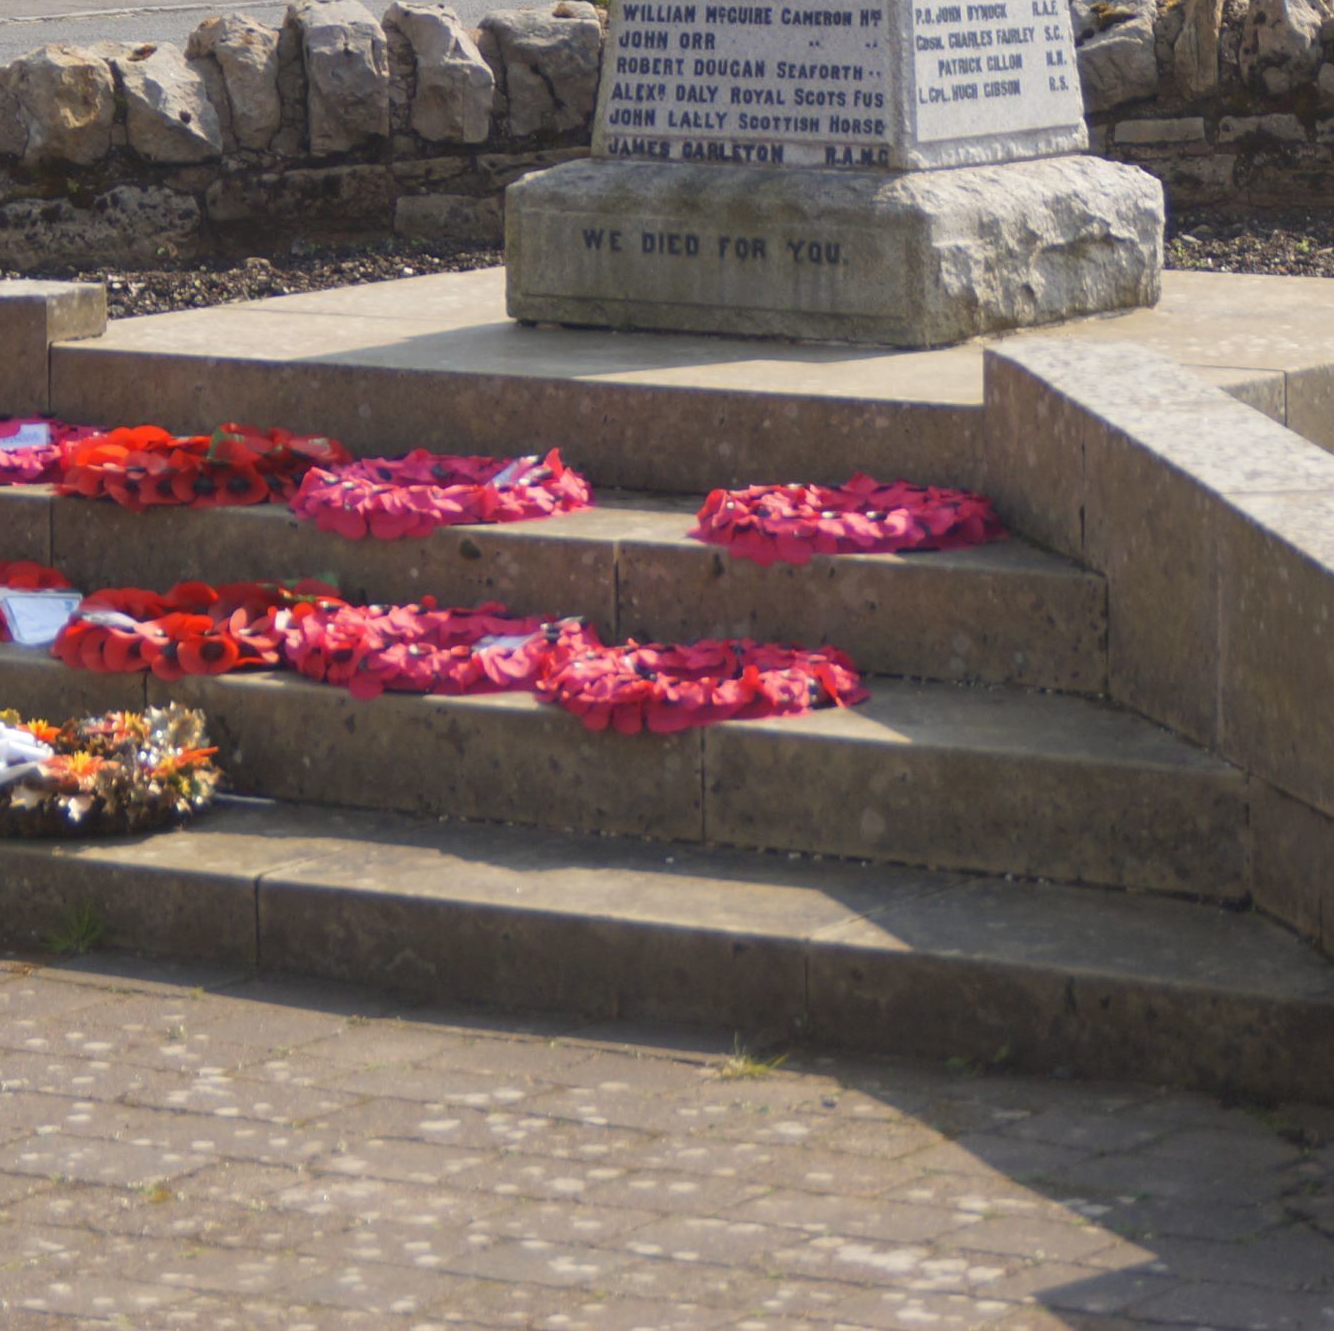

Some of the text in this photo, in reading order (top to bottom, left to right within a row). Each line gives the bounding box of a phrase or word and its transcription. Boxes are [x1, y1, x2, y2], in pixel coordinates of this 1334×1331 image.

[622, 4, 697, 23] WILLIAM
[781, 7, 852, 27] CAMERON
[935, 5, 962, 24] JOHN
[619, 31, 716, 50] JOHN ORR
[948, 29, 993, 49] CHARLES
[996, 25, 1035, 45] FAIRLEY
[616, 57, 685, 76] ROBERT
[776, 61, 863, 81] SEAFORTH
[937, 56, 983, 78] PATRICK
[675, 84, 719, 104] DALY
[730, 86, 786, 106] ROYAL
[794, 88, 847, 107] SCOTS
[609, 108, 886, 136] JOHN LALLY SCOTTISH HORSE
[608, 137, 671, 158] JAMES
[582, 228, 850, 266] WE DIED FOR YOU.
